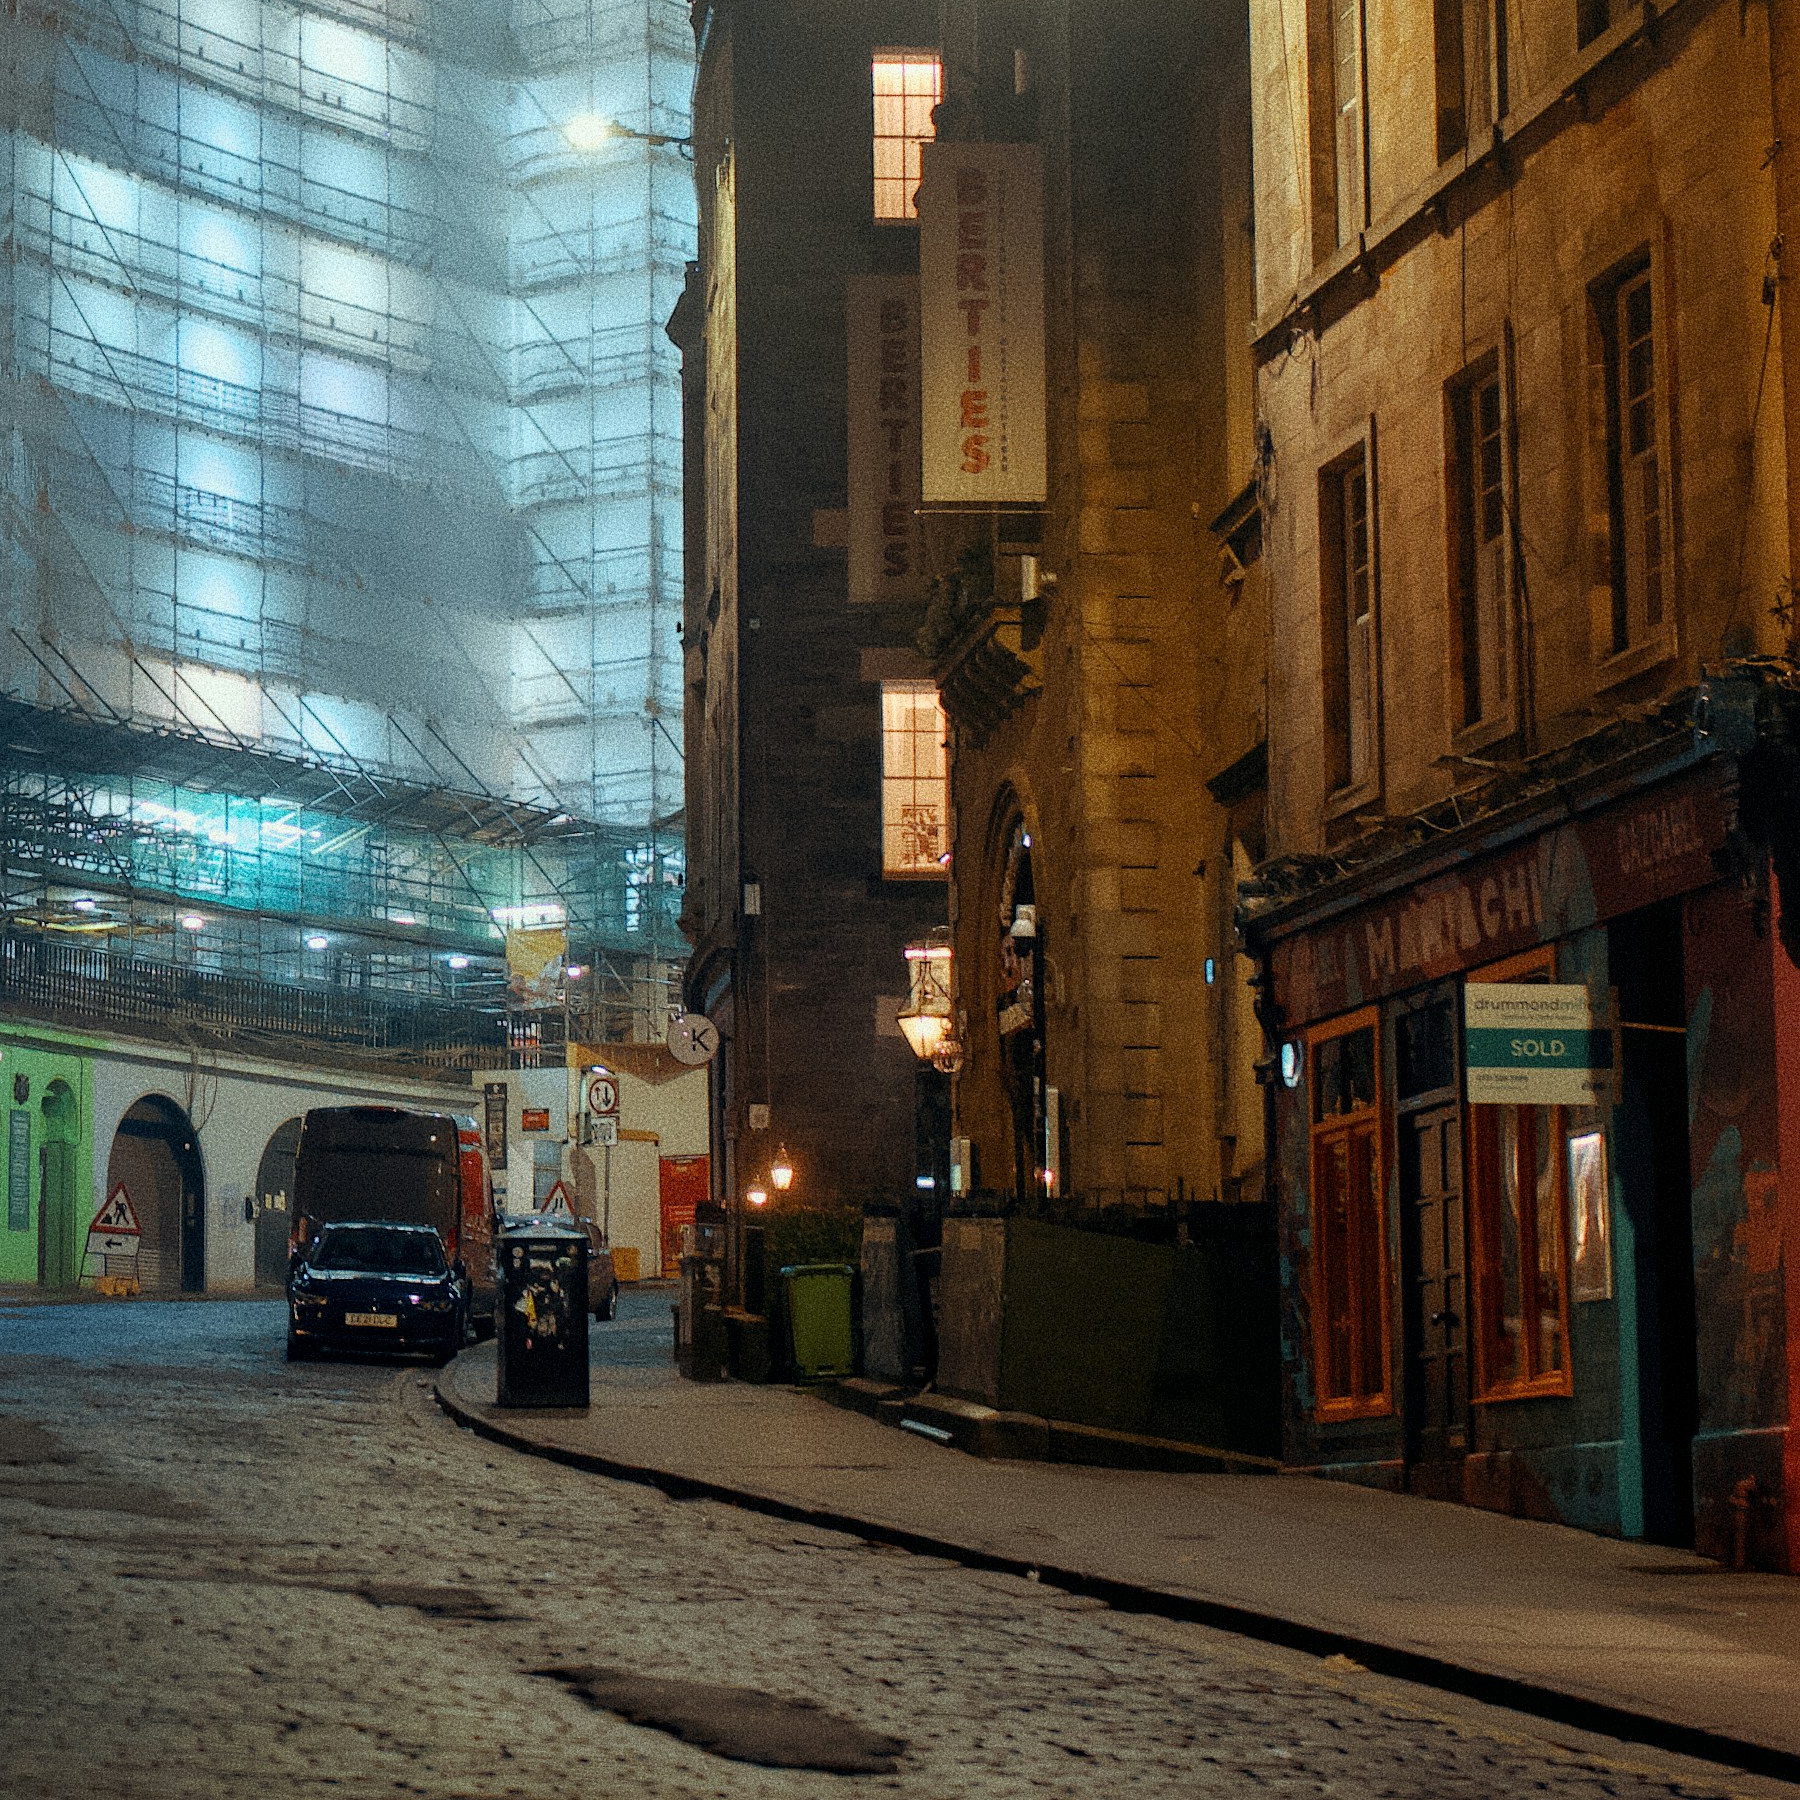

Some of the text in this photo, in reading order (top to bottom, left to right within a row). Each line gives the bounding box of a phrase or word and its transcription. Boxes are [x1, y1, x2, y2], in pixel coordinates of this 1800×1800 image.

[955, 167, 991, 475] BERTIES
[879, 298, 910, 578] BERTIES
[691, 1027, 711, 1052] K
[1510, 1038, 1566, 1058] SOLD
